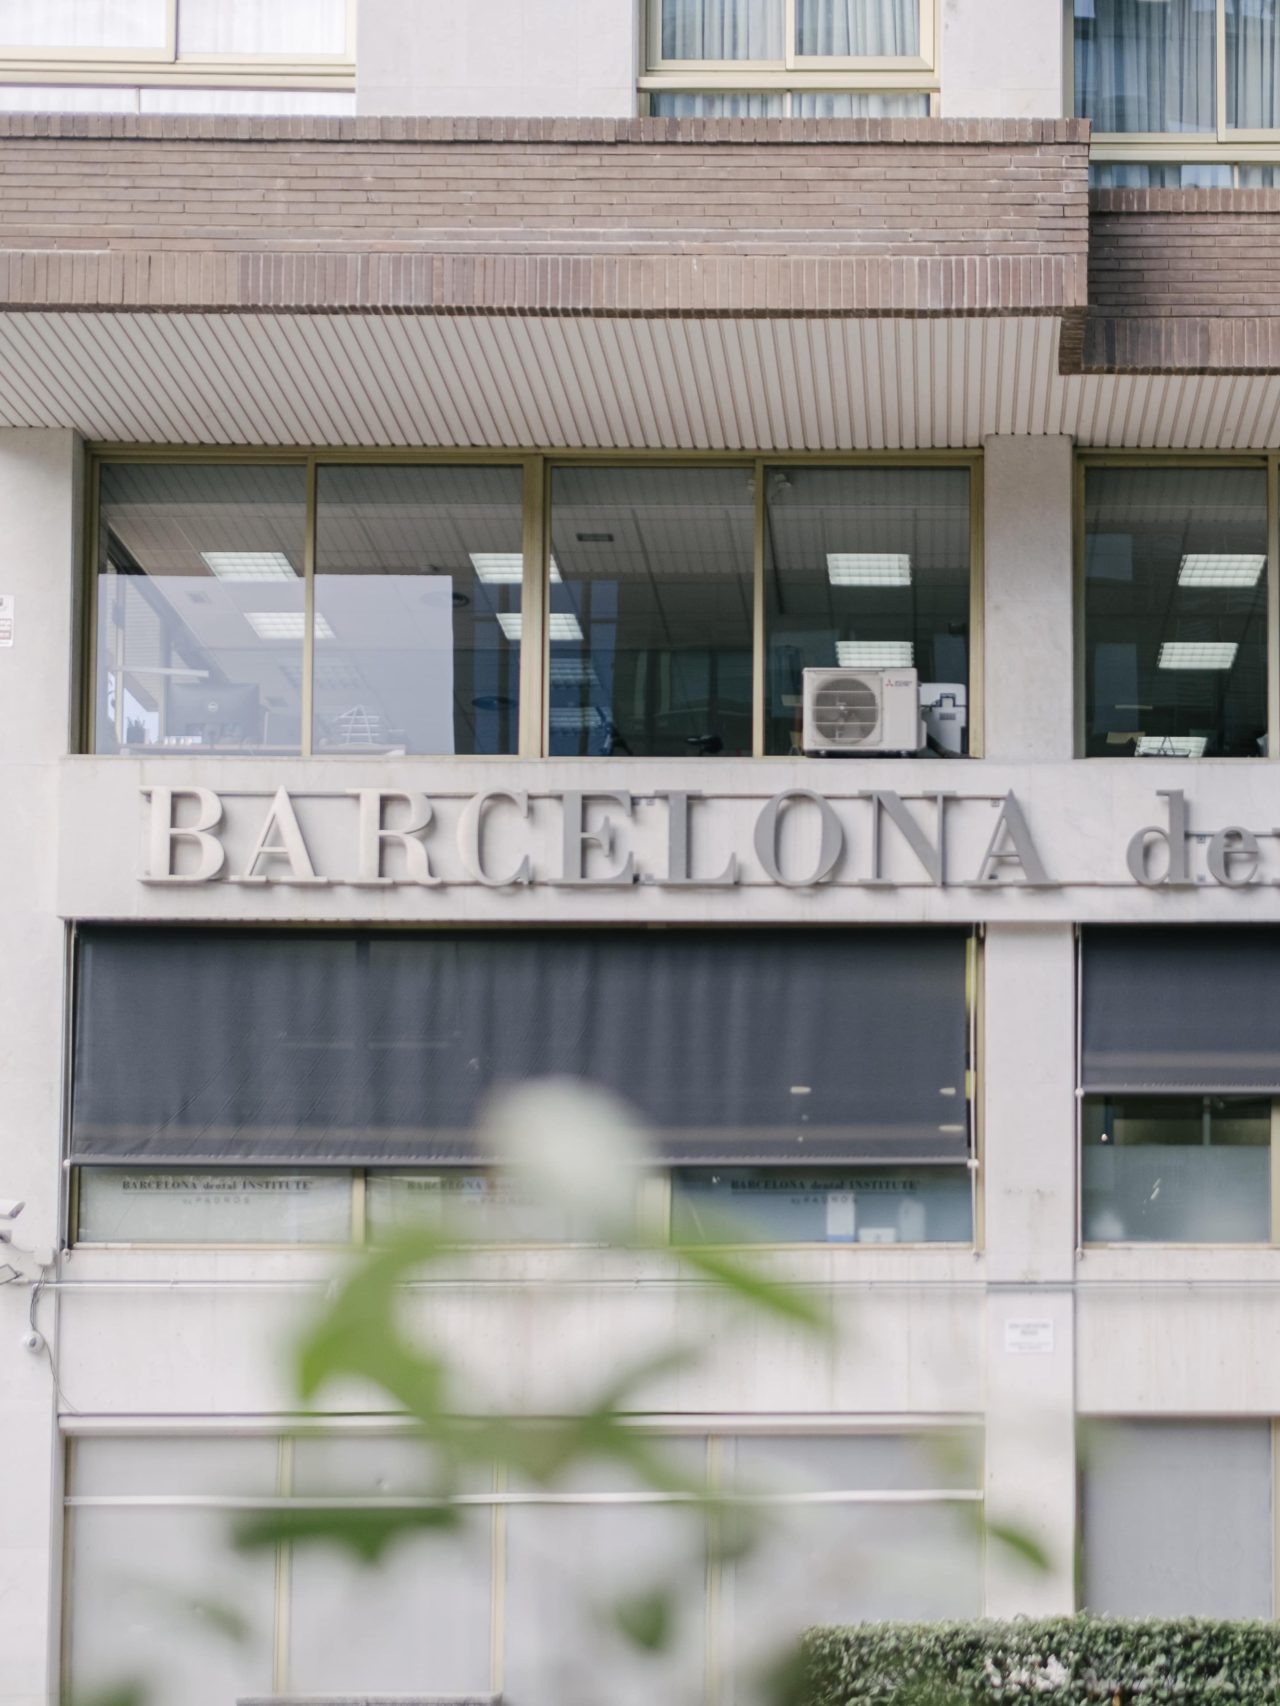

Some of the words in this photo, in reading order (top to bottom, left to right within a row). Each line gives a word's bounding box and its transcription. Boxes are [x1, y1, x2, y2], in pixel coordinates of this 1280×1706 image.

[138, 785, 1059, 887] BARCELONA
[122, 1180, 197, 1190] BARCELONA
[202, 1180, 237, 1190] dental
[242, 1181, 310, 1190] INSTITUTE
[731, 1180, 805, 1190] BARCELONA
[810, 1180, 844, 1190] dental
[849, 1180, 916, 1190] INSTITUTE
